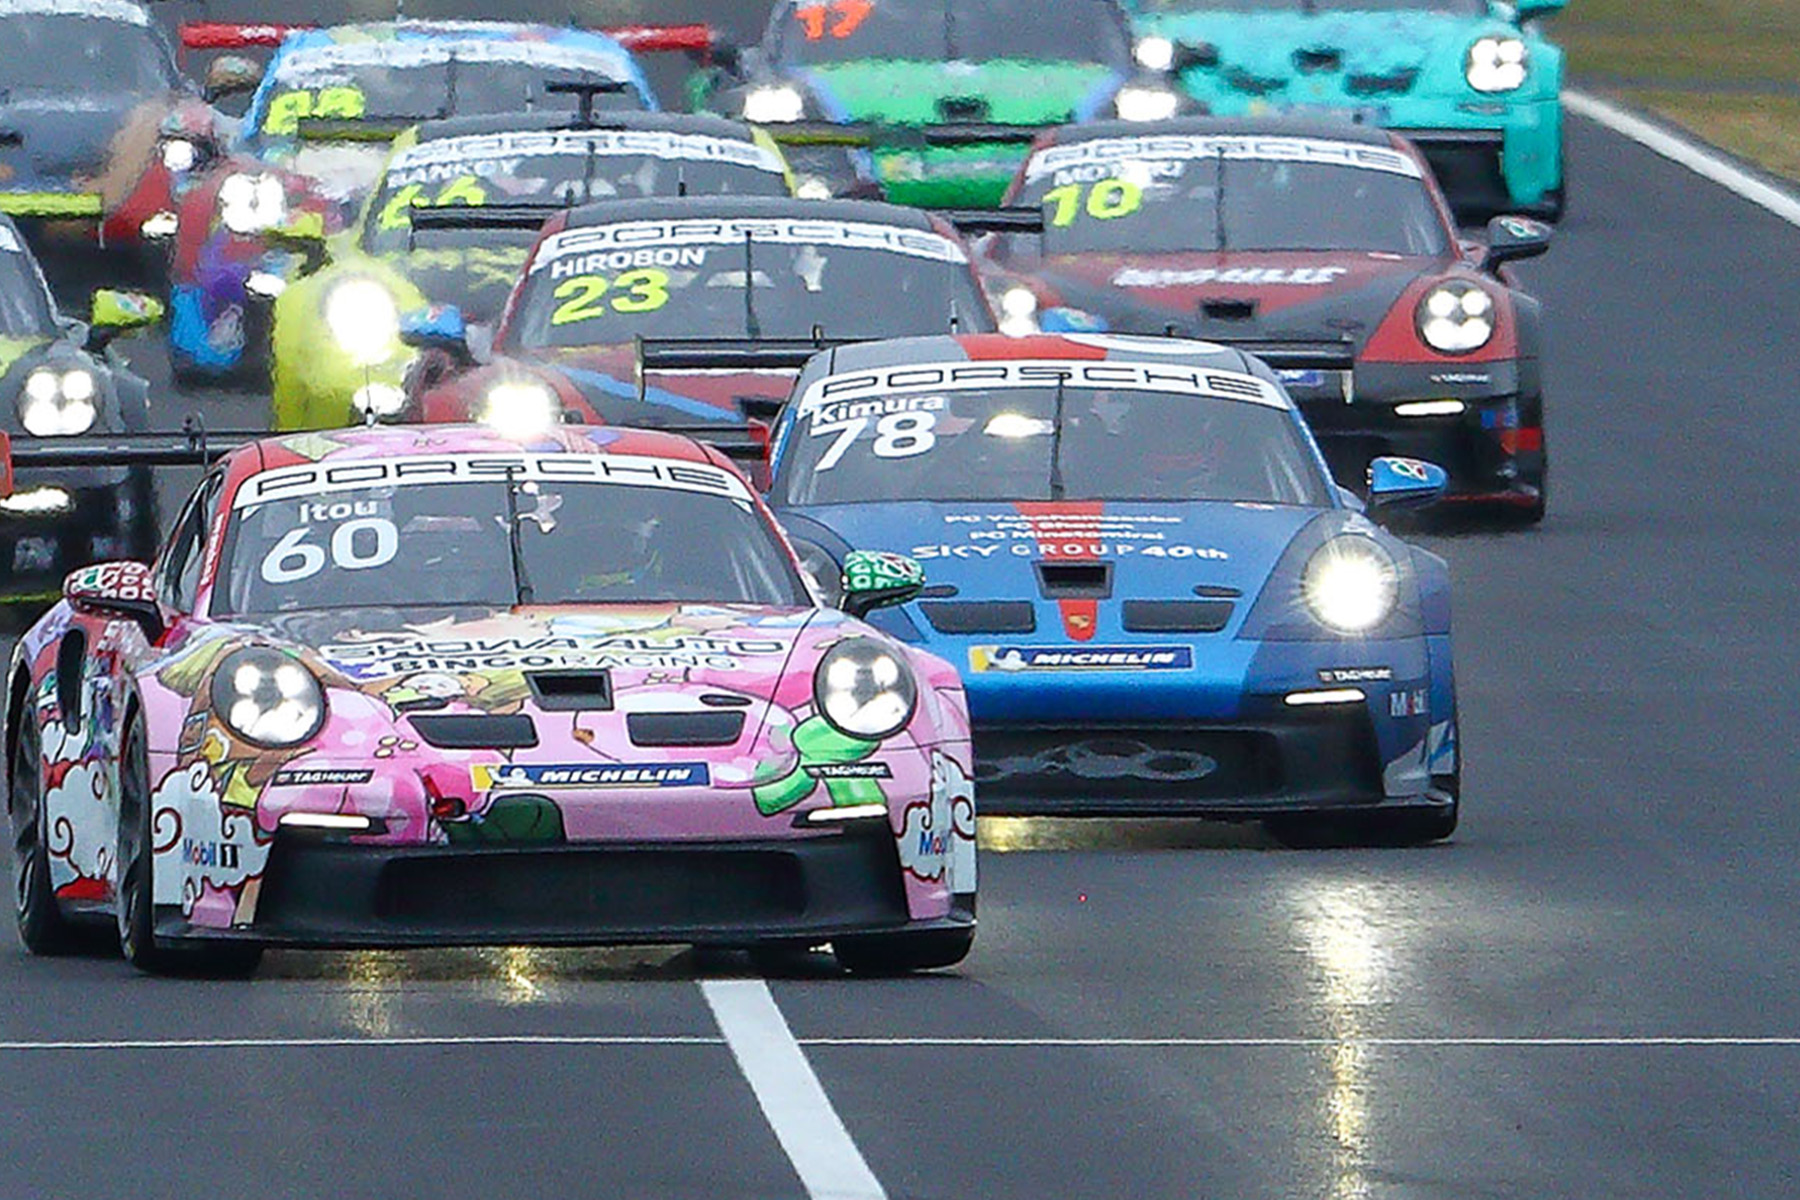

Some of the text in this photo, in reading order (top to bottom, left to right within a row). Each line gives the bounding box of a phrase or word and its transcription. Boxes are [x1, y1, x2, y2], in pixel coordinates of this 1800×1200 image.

[1042, 179, 1143, 228] 10
[551, 246, 707, 281] HIROBON
[550, 267, 671, 327] 23
[822, 365, 1265, 399] PORSCHE
[809, 395, 945, 427] Kimura
[809, 411, 938, 473] 78
[256, 458, 731, 497] PORSCHE
[299, 500, 378, 524] Itou
[260, 517, 400, 585] 60
[911, 544, 1000, 560] SKY
[1011, 543, 1136, 557] GROUP
[327, 637, 786, 661] SHOWA AUTO
[1034, 651, 1176, 667] MICHELIN
[540, 767, 691, 785] MICHELIN
